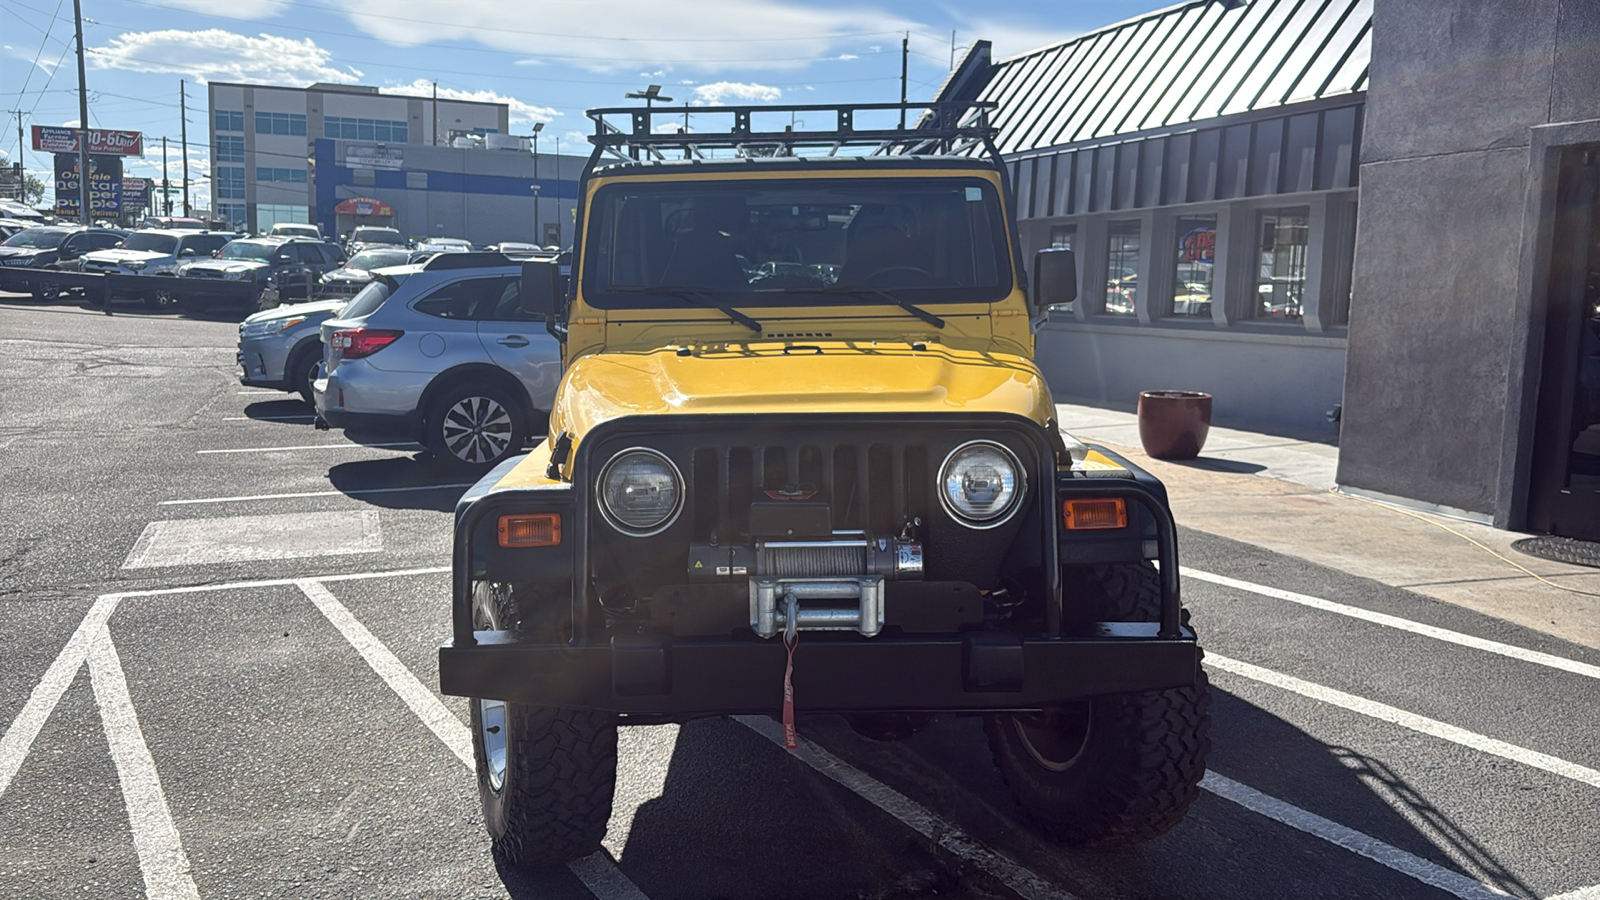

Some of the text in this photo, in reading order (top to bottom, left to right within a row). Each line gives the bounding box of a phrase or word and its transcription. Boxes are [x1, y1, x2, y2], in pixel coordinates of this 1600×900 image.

[89, 173, 111, 181] ale
[56, 180, 119, 191] netar
[56, 199, 119, 209] puple
[348, 197, 380, 205] ENTRANCE
[91, 209, 119, 218] Delivery
[1185, 229, 1216, 262] OPE
[785, 724, 796, 747] WARN
